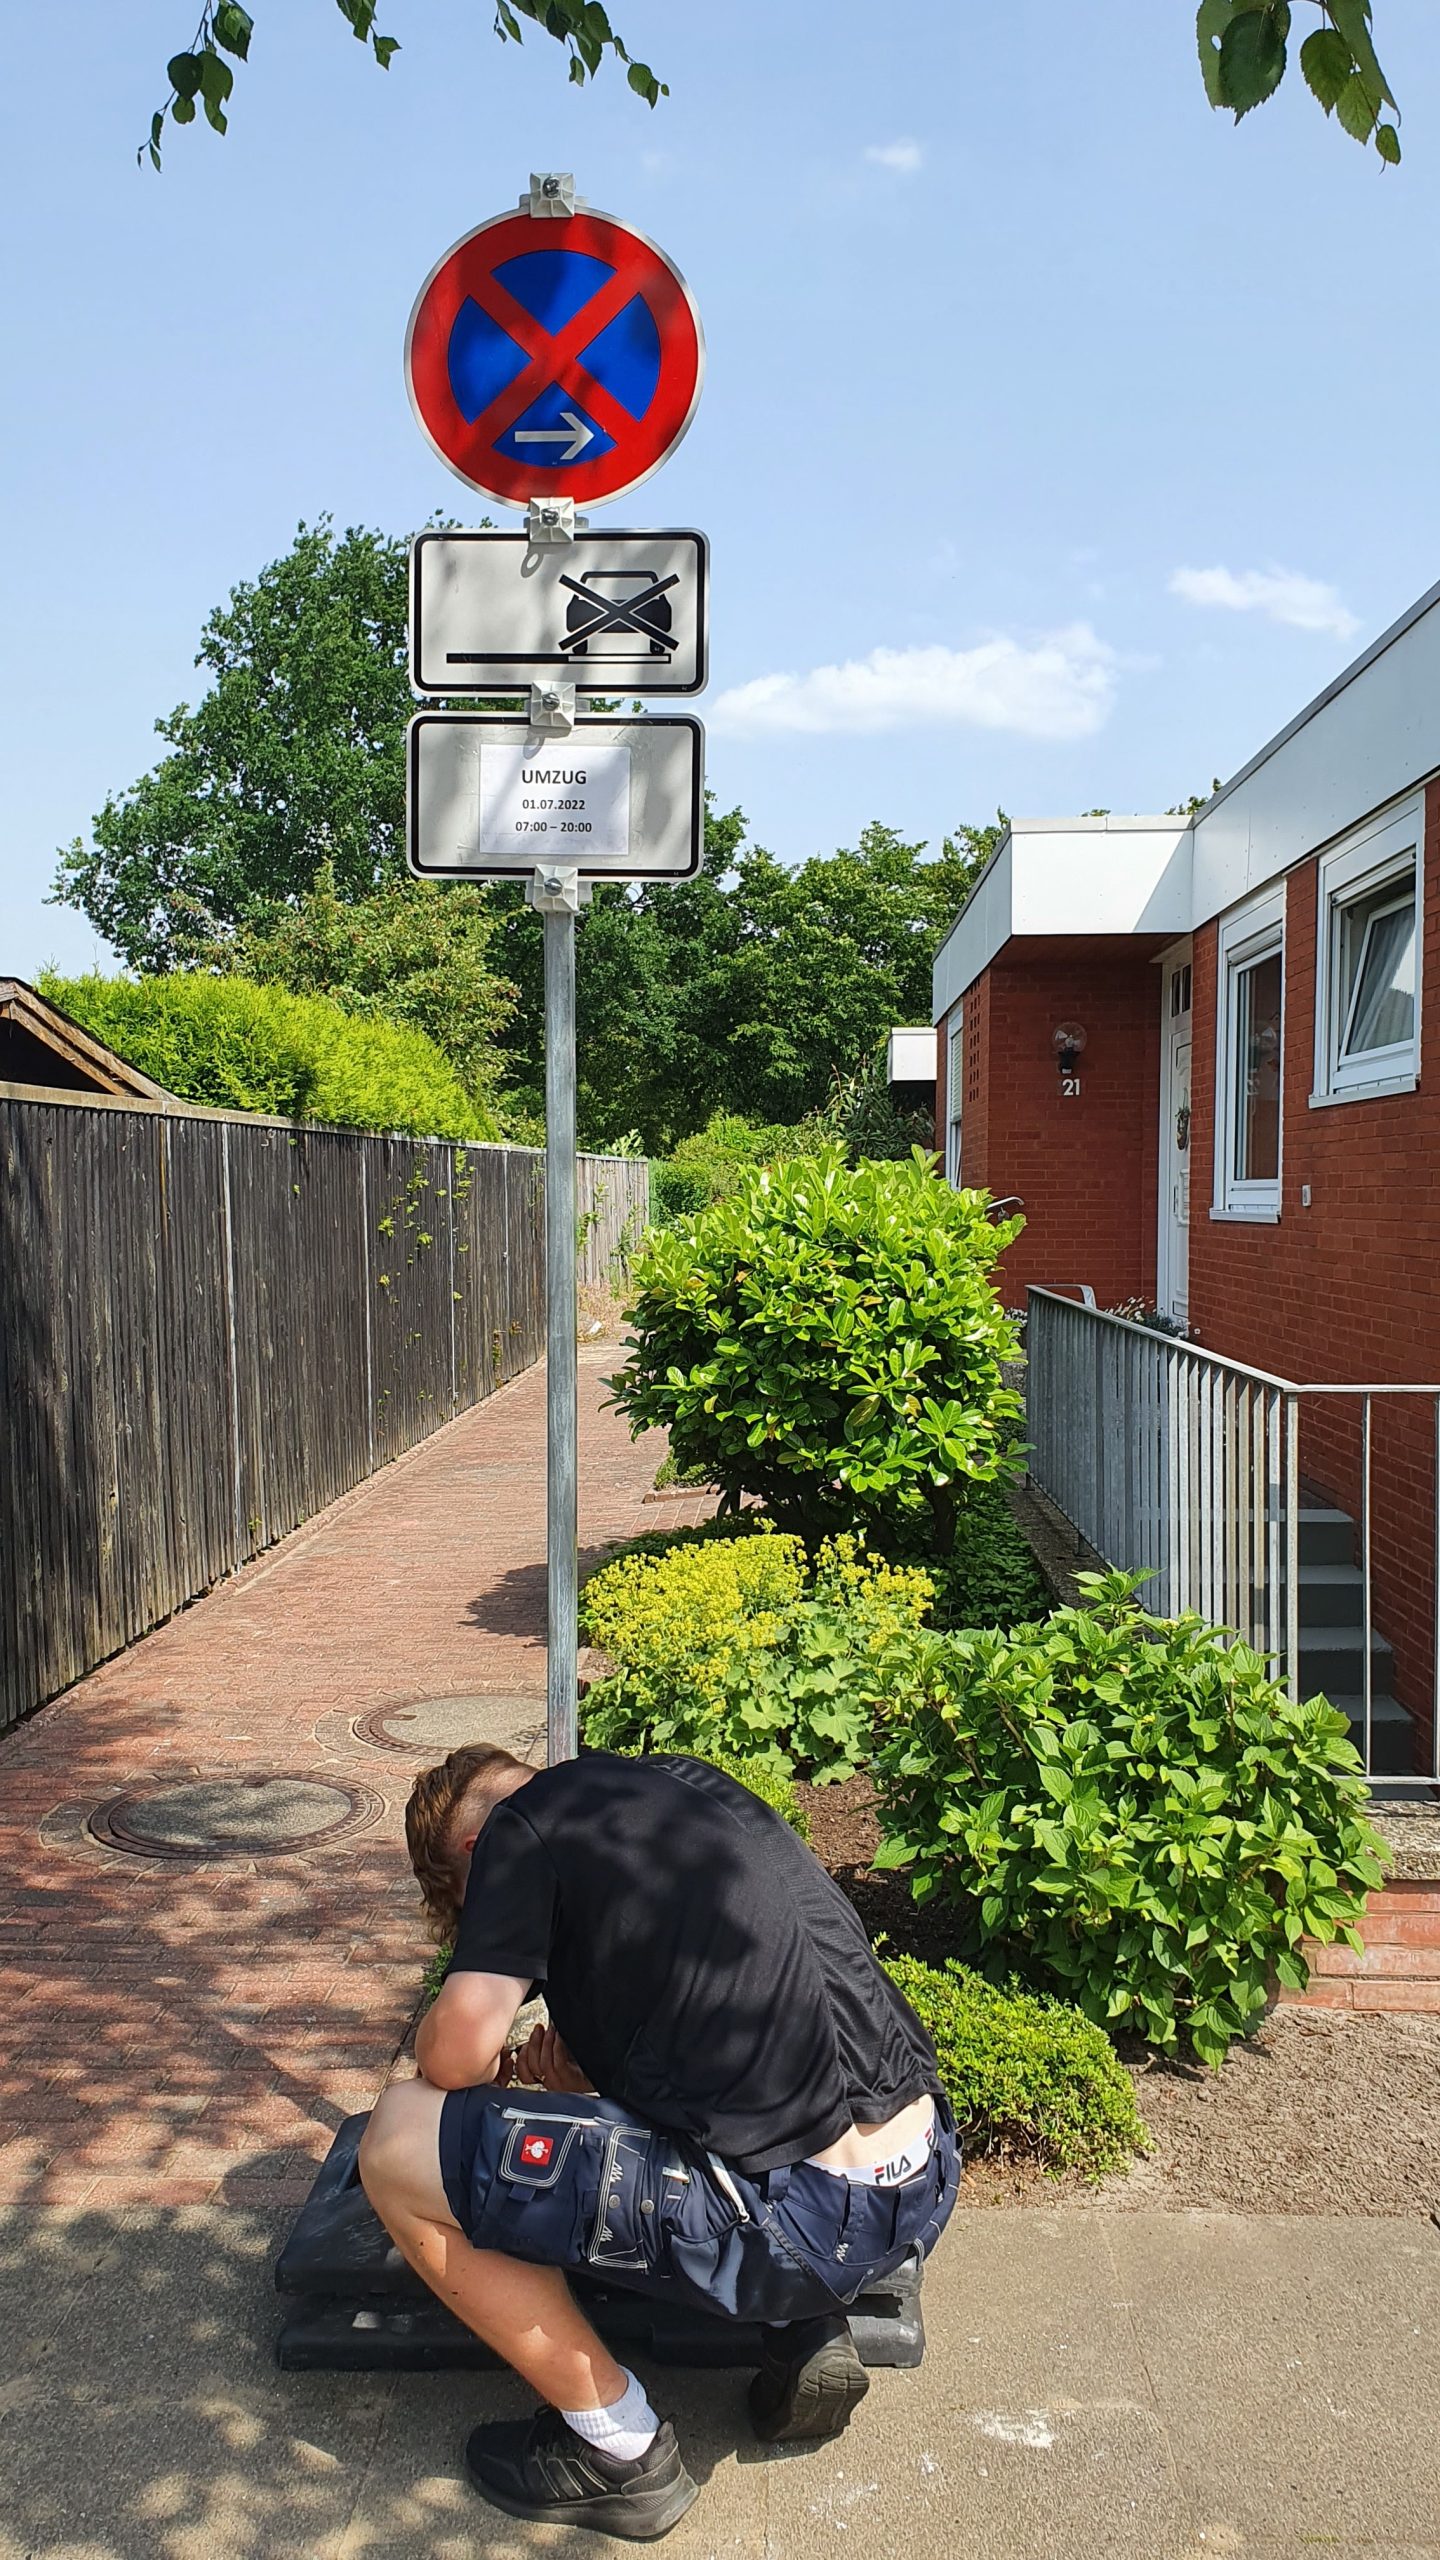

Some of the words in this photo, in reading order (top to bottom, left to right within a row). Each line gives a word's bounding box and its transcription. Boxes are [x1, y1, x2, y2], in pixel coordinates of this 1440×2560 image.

[521, 769, 587, 785] UMZUG
[522, 799, 586, 810] 01.07.2022
[515, 821, 547, 832] 07:00
[560, 822, 592, 833] 20:00
[1062, 1078, 1080, 1096] 21
[874, 2154, 912, 2184] FILA
